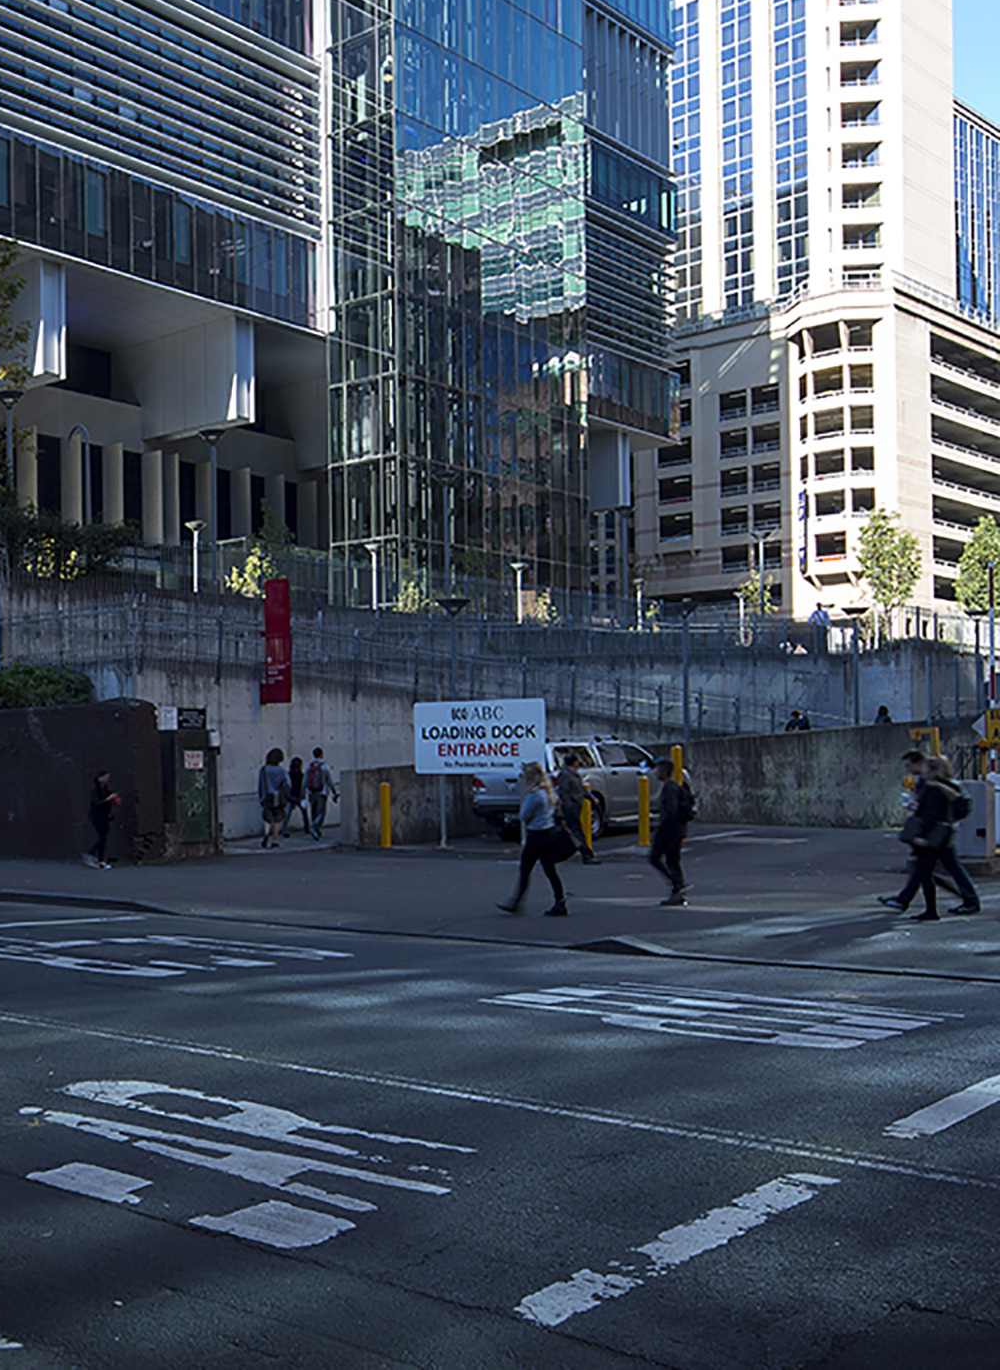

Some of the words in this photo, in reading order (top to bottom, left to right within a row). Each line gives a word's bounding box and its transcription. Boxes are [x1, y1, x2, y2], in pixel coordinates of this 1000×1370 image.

[470, 705, 504, 721] ABC
[421, 725, 487, 740] LOADING
[491, 724, 536, 739] DOCK
[438, 742, 520, 757] ENTRANCE
